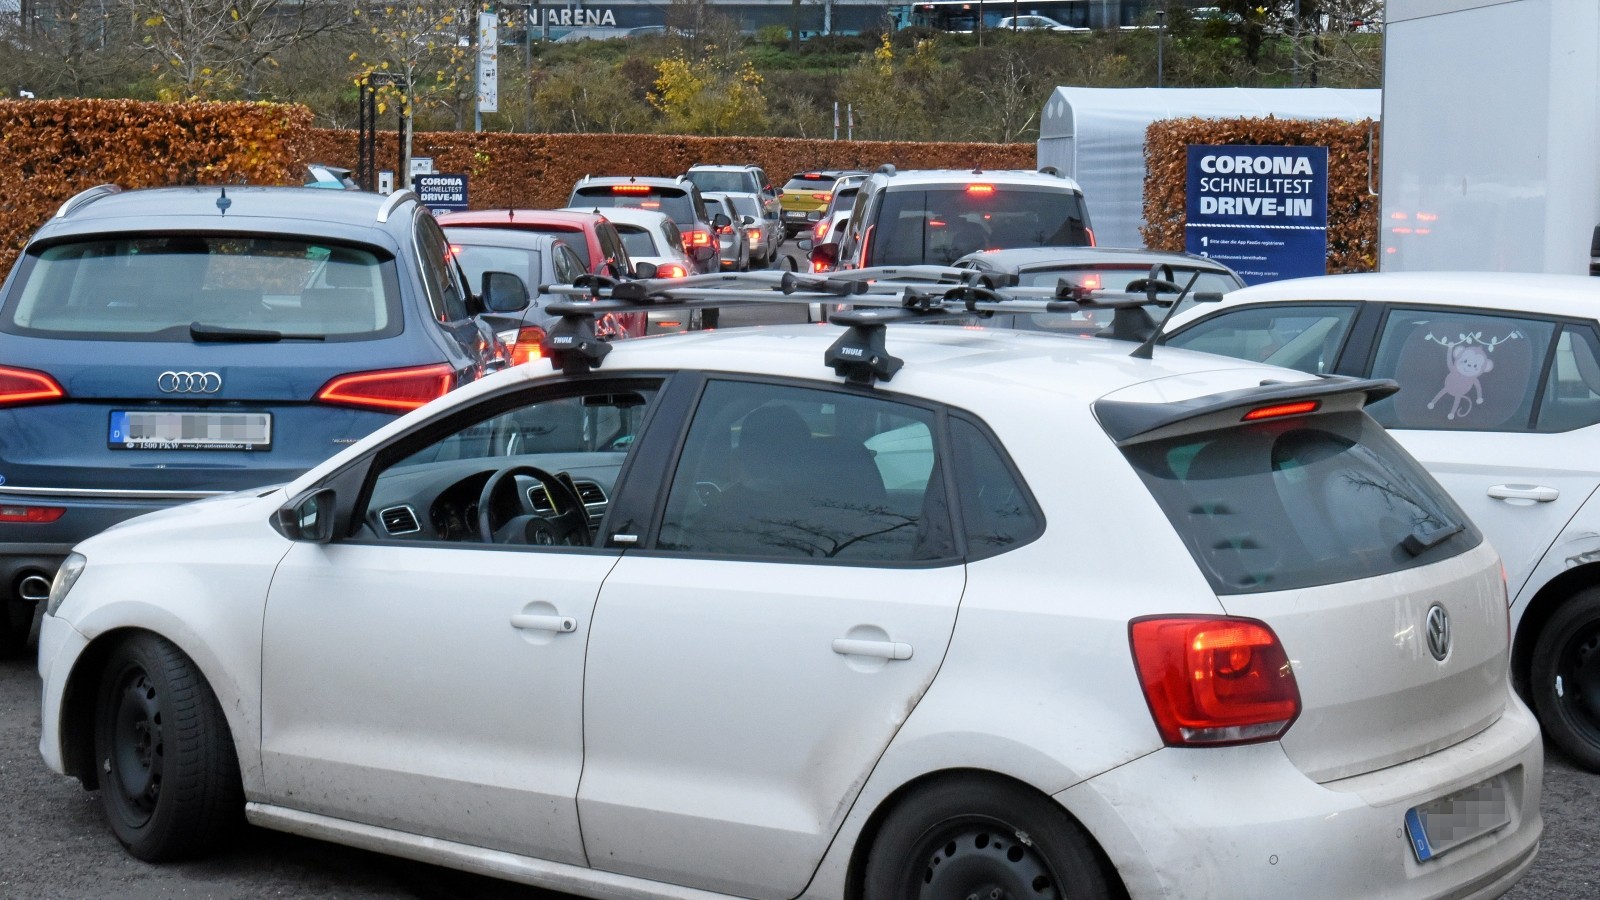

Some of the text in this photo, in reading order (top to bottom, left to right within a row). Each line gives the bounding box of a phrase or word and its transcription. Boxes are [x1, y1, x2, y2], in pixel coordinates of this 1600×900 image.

[549, 9, 616, 26] ARENA
[1200, 155, 1313, 175] CORONA
[420, 177, 463, 186] CORONA
[1200, 177, 1313, 194] SCHNELLTEST
[420, 193, 463, 202] DRIVE-IN
[1200, 196, 1313, 217] DRIVE-IN
[1200, 236, 1208, 247] 1
[841, 347, 864, 357] THULE
[113, 430, 120, 438] D
